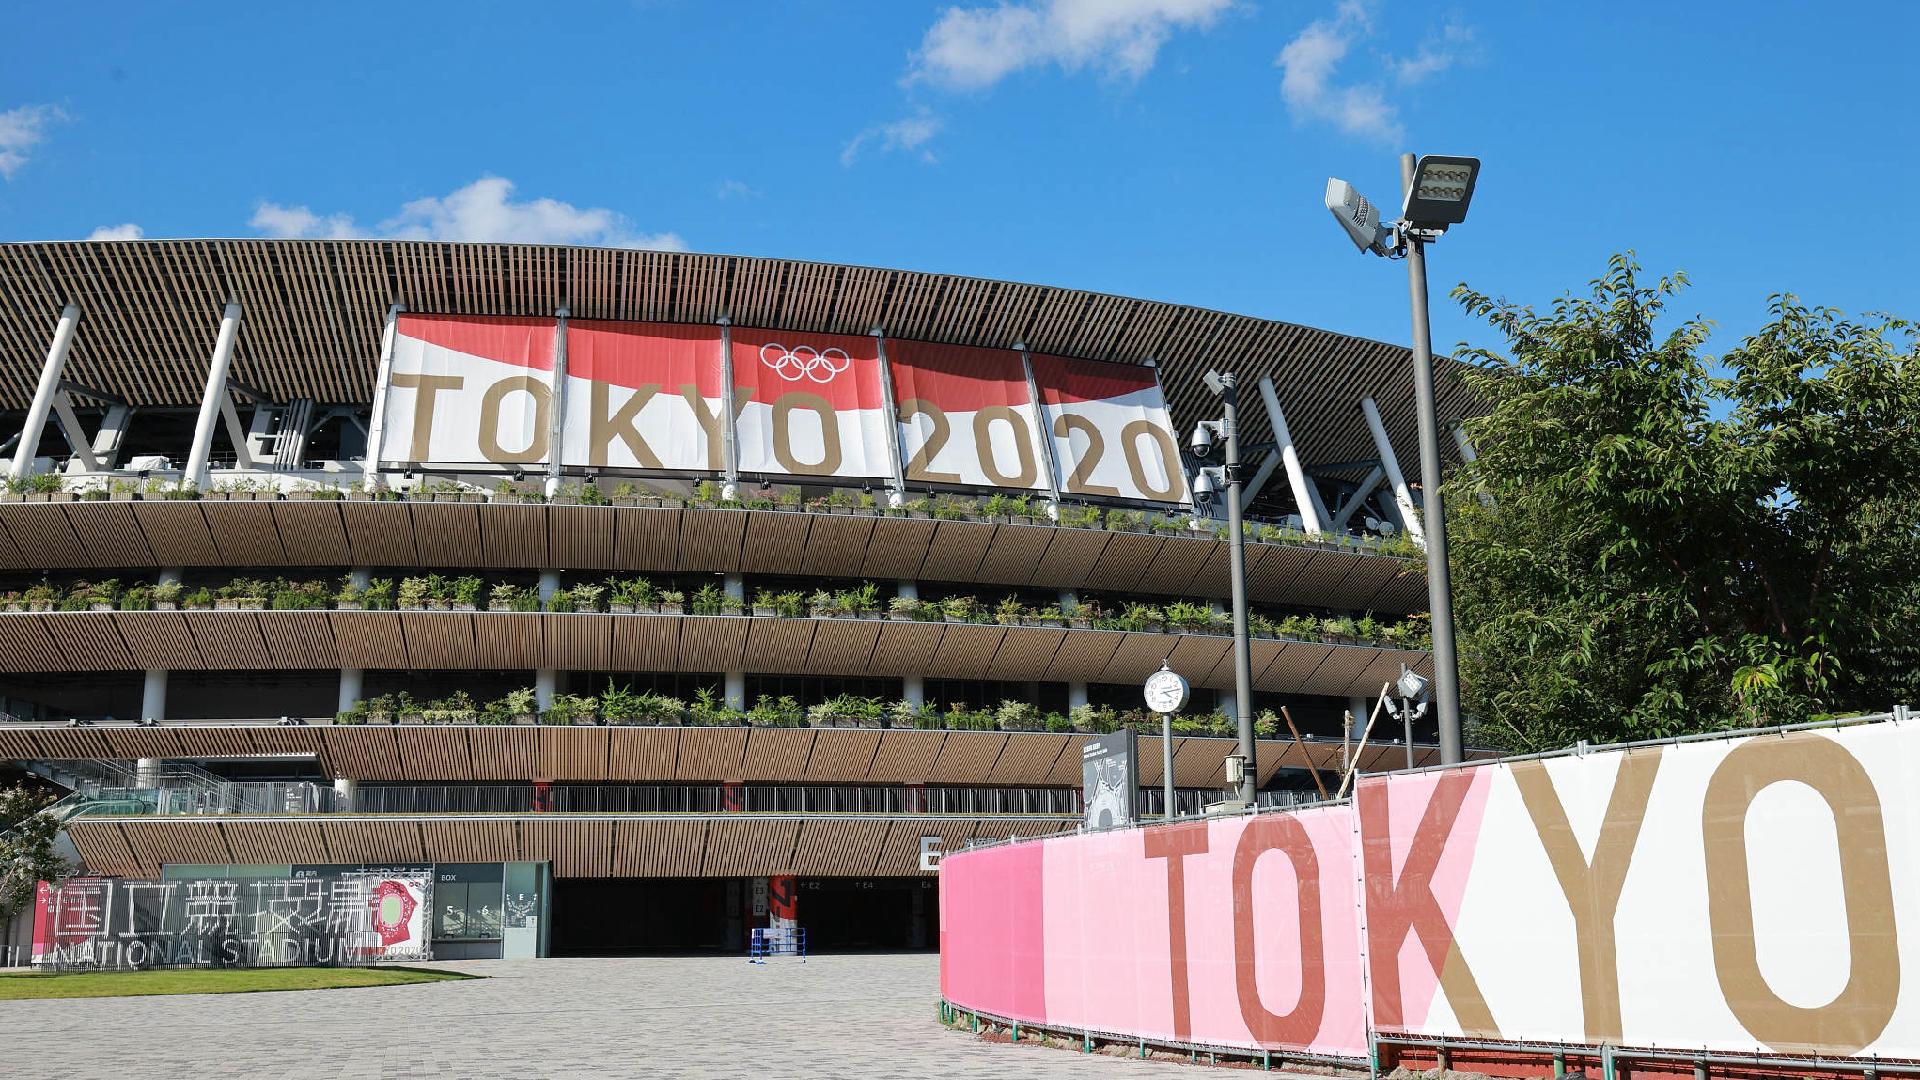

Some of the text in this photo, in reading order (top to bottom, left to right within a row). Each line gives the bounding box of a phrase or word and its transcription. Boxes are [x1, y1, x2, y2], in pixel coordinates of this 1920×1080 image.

[391, 372, 1185, 502] TOKYO 2020
[920, 836, 942, 871] E
[446, 905, 454, 916] 5
[482, 905, 489, 915] 6
[1144, 731, 1901, 1057] TOKYO
[52, 935, 365, 969] NATIONAL STADIUM
